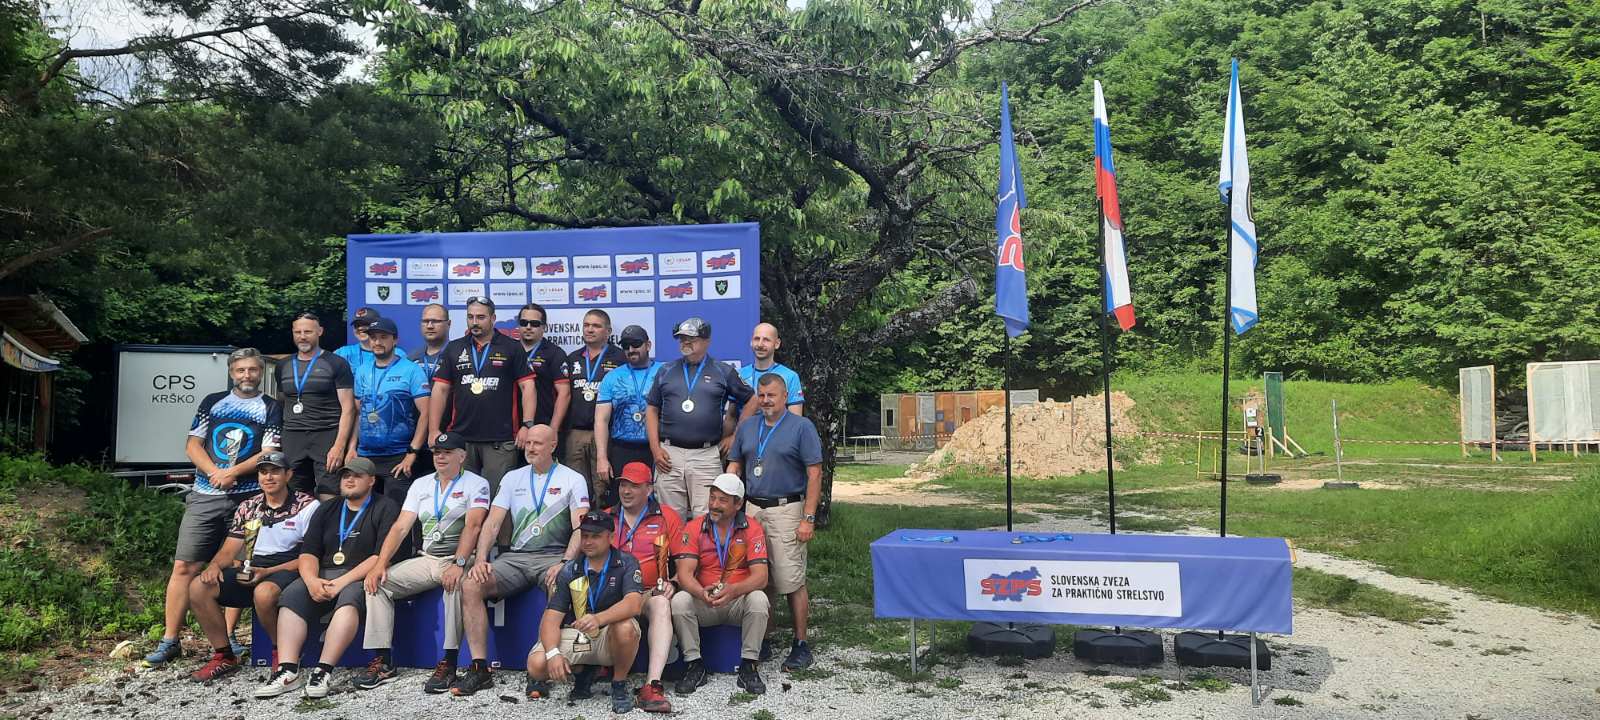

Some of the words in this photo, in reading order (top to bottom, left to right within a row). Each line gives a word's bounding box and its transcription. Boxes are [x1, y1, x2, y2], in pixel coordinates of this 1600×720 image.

[544, 323, 580, 333] OVENSKA
[153, 375, 195, 390] CPS
[461, 374, 475, 384] SIG
[152, 393, 195, 403] KRŠKO
[1256, 428, 1263, 436] 2
[1050, 575, 1100, 586] SLOVENSKA
[1103, 576, 1130, 587] ZVEZA
[981, 578, 1042, 596] SZPS
[1052, 588, 1063, 598] ZA
[1065, 587, 1113, 600] PRAKTIČNO
[1116, 589, 1165, 601] STRELSTVO
